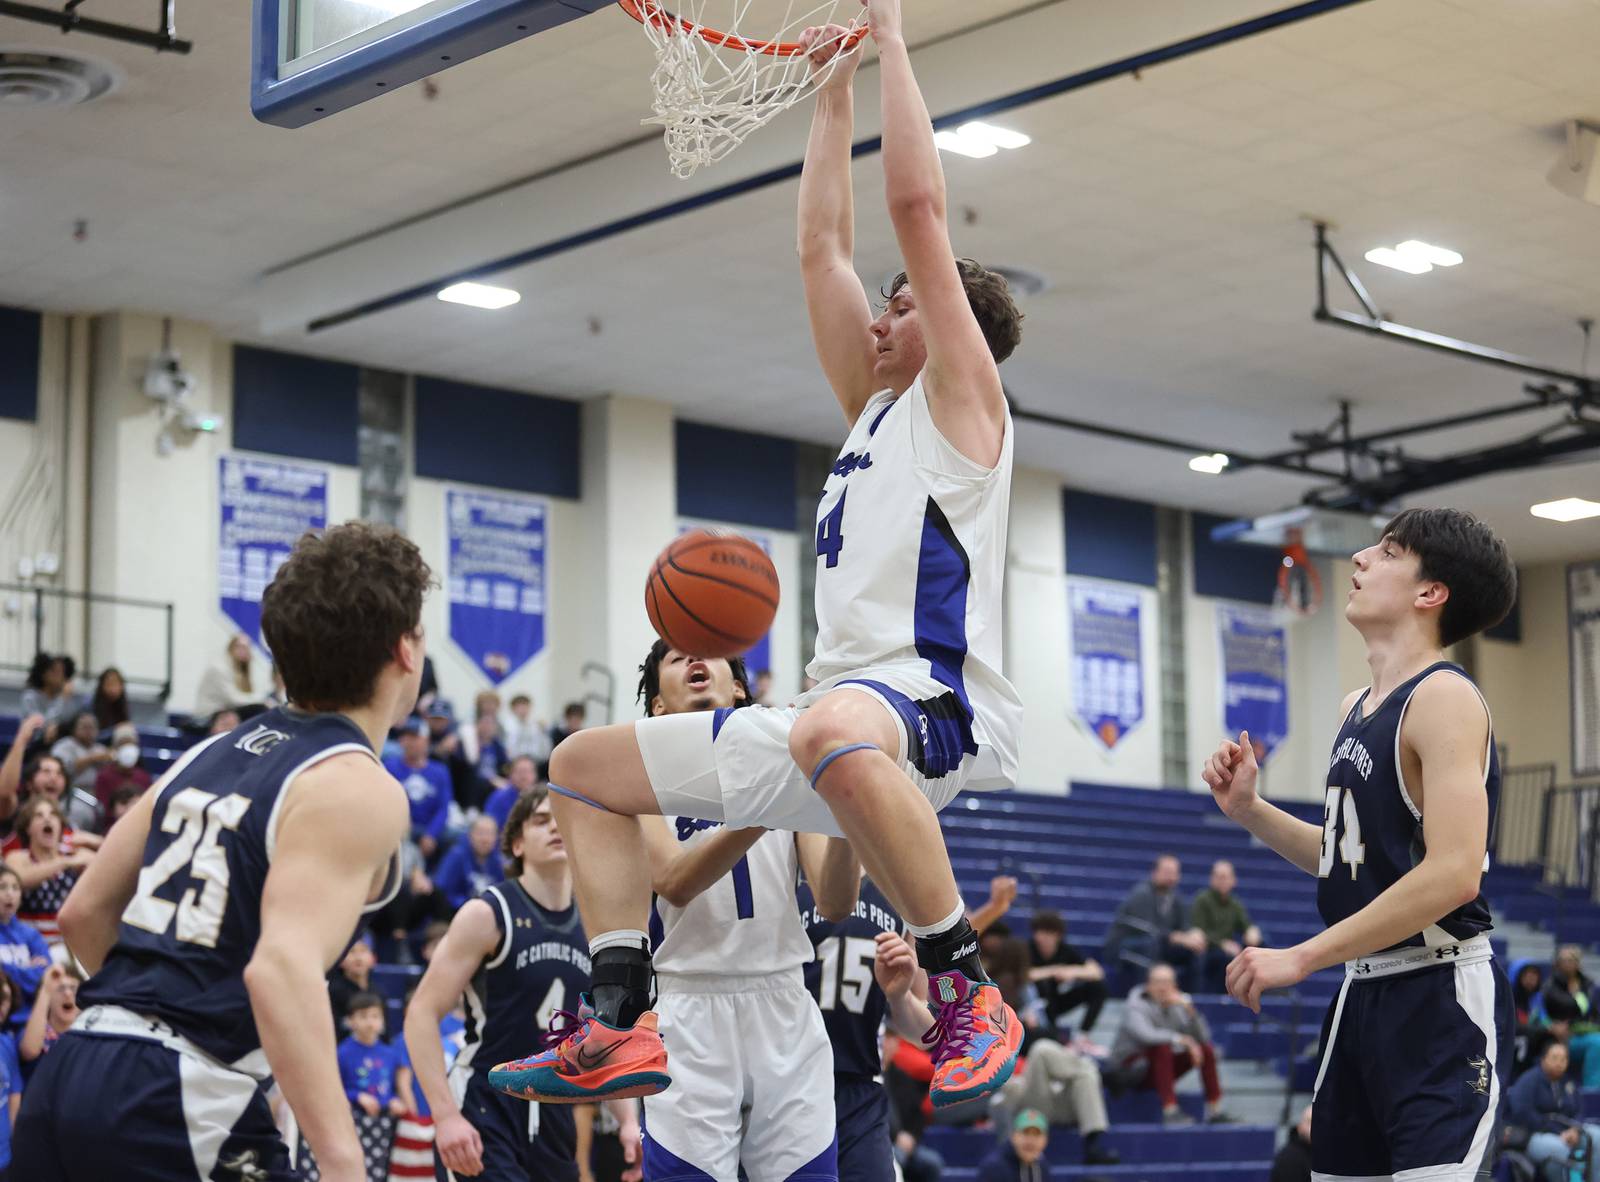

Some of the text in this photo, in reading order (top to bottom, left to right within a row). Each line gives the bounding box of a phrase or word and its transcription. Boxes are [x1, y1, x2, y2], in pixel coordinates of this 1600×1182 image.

[816, 483, 848, 569] 4
[121, 787, 252, 948] 25
[529, 942, 571, 963] CATHOLIC
[870, 903, 897, 933] PREP
[535, 977, 566, 1041] 4
[816, 936, 879, 1014] 15
